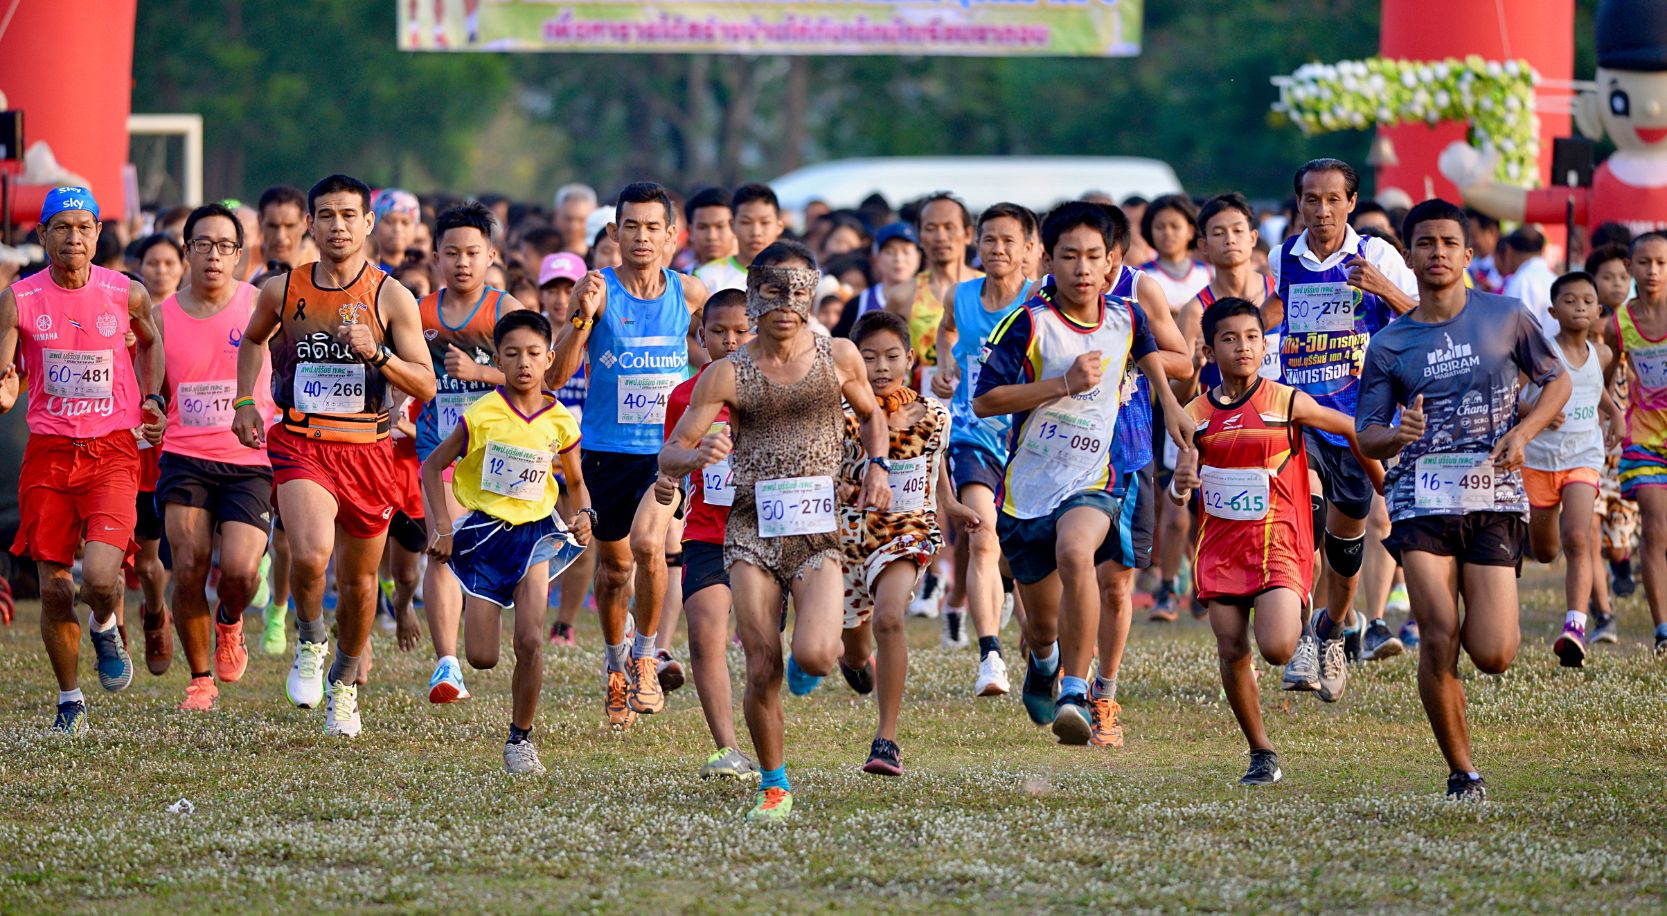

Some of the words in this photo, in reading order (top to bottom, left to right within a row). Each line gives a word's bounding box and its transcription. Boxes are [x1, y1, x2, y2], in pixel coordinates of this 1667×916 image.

[63, 198, 84, 209] sky
[32, 332, 58, 341] YAMAHA
[618, 351, 687, 369] Columbi
[1423, 355, 1480, 378] BURIRAM
[1434, 367, 1471, 380] MARATHON
[47, 395, 114, 417] Chang
[1456, 403, 1489, 416] Chang
